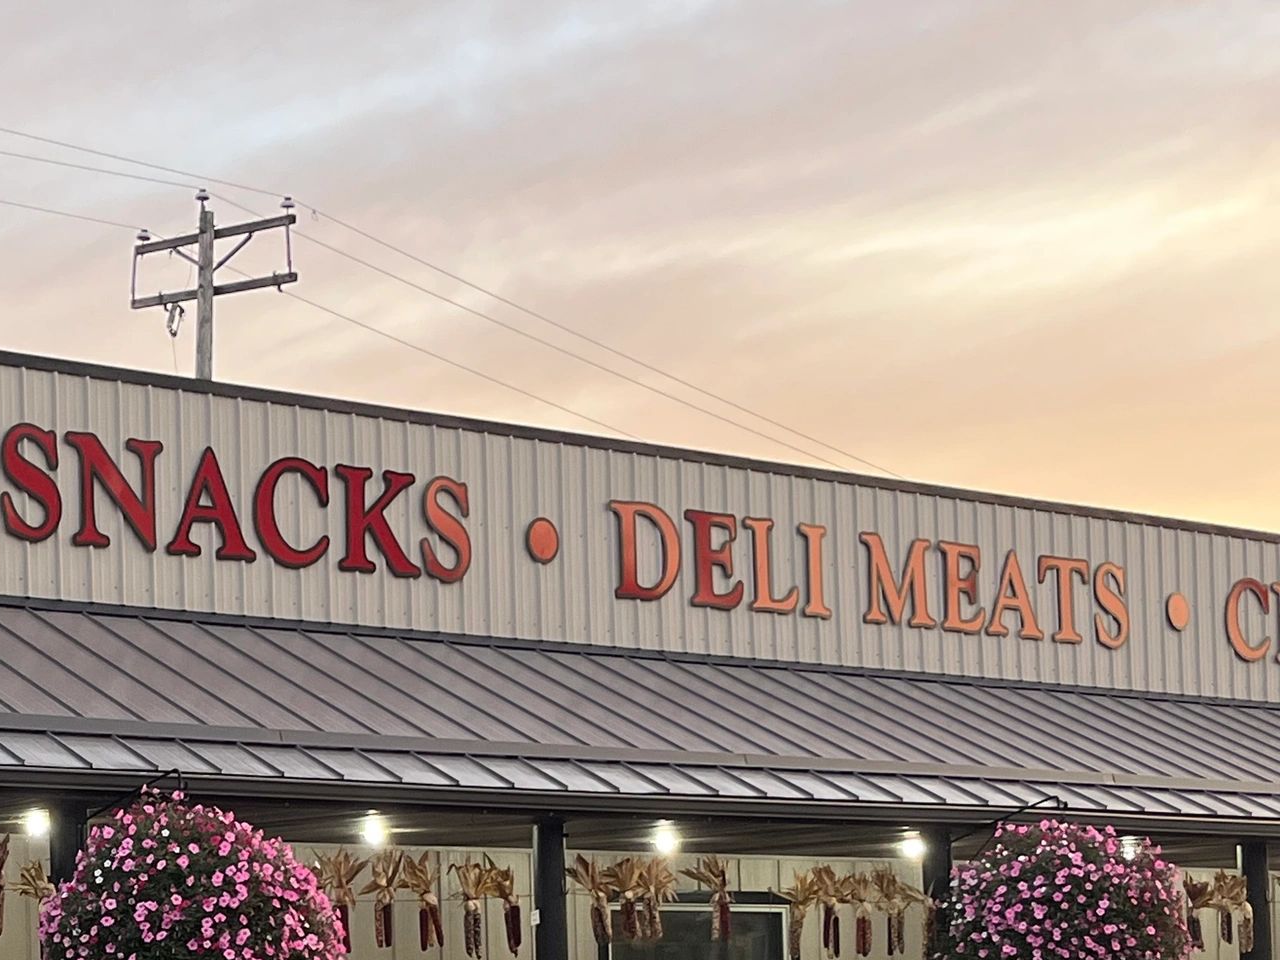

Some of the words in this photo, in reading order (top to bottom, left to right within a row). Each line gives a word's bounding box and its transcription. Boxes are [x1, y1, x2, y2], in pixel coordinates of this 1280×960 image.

[0, 421, 472, 583] SNACKS
[608, 499, 834, 622] DELI
[860, 530, 1131, 650] MEATS
[1225, 577, 1280, 664] C
